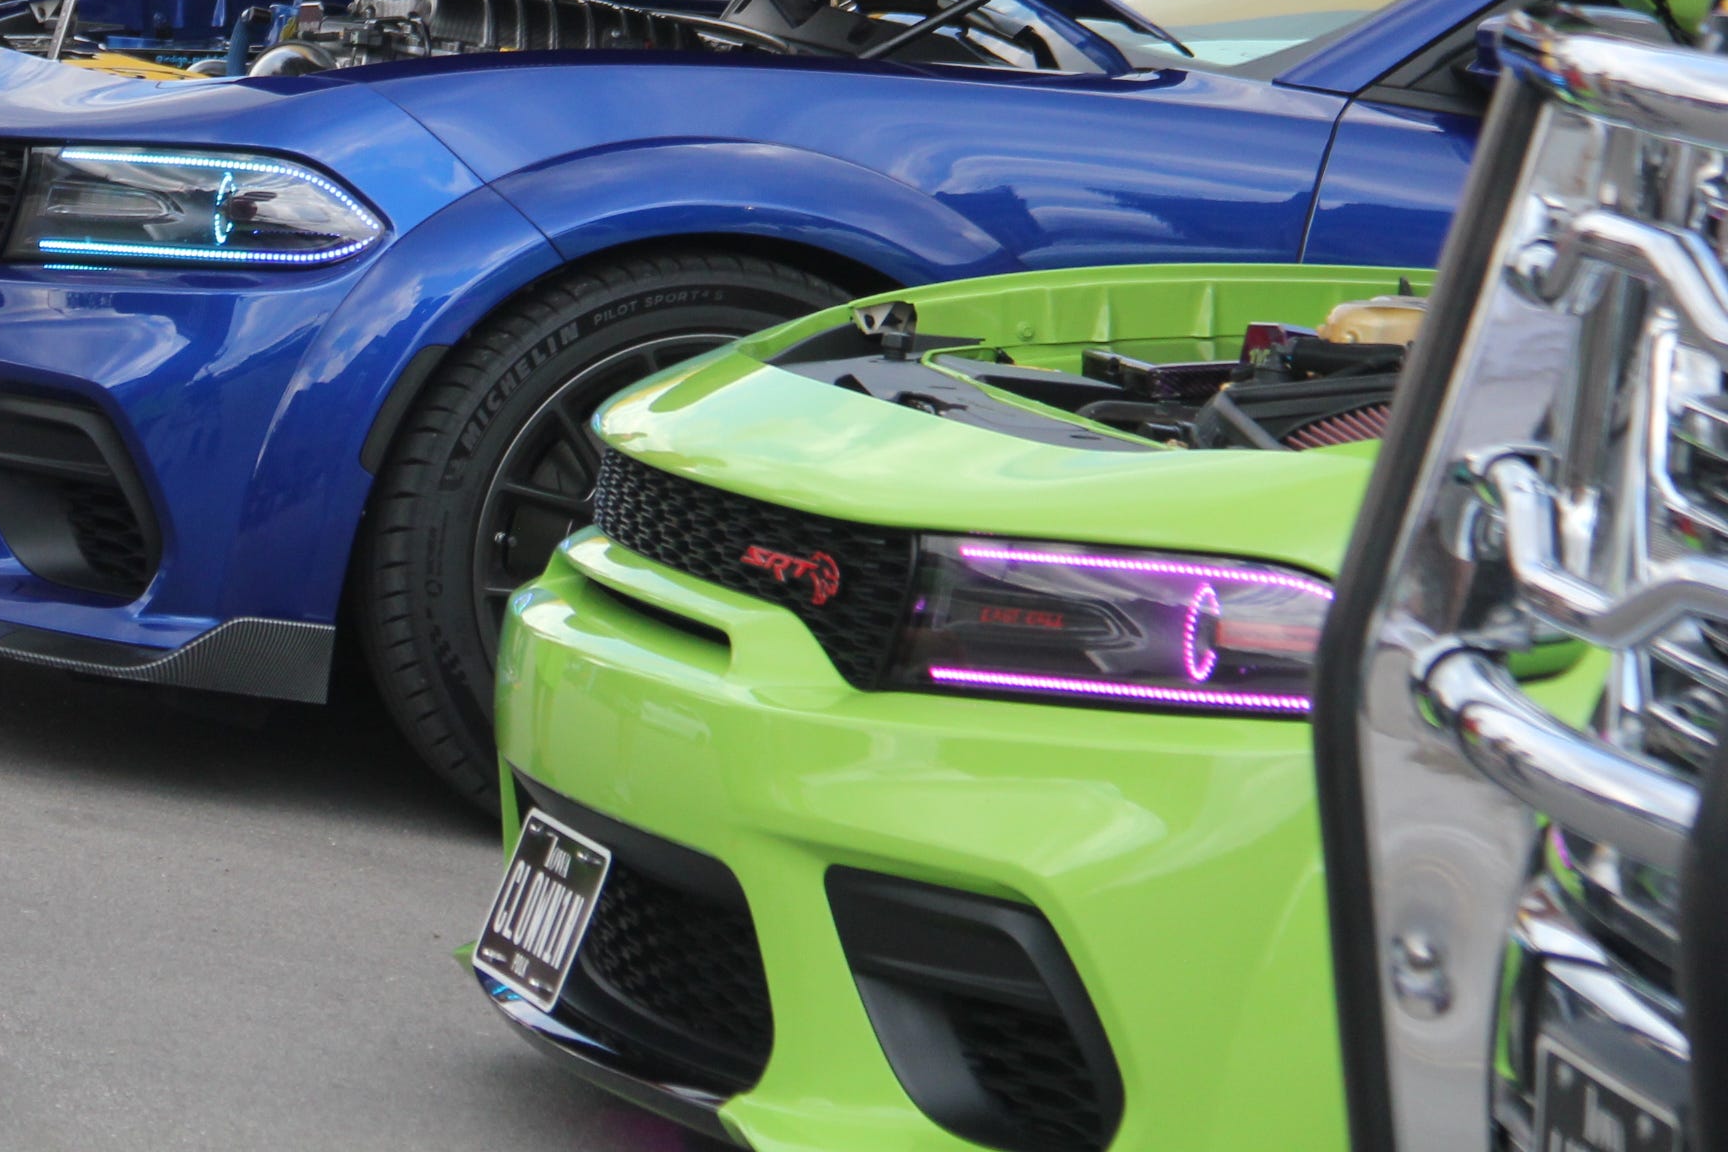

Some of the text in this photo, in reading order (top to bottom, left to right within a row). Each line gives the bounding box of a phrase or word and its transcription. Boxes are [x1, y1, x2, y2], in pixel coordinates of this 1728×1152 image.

[459, 321, 580, 451] MICHELIN
[593, 301, 638, 326] PILOT
[643, 289, 701, 309] SPORT
[740, 544, 820, 582] SRT
